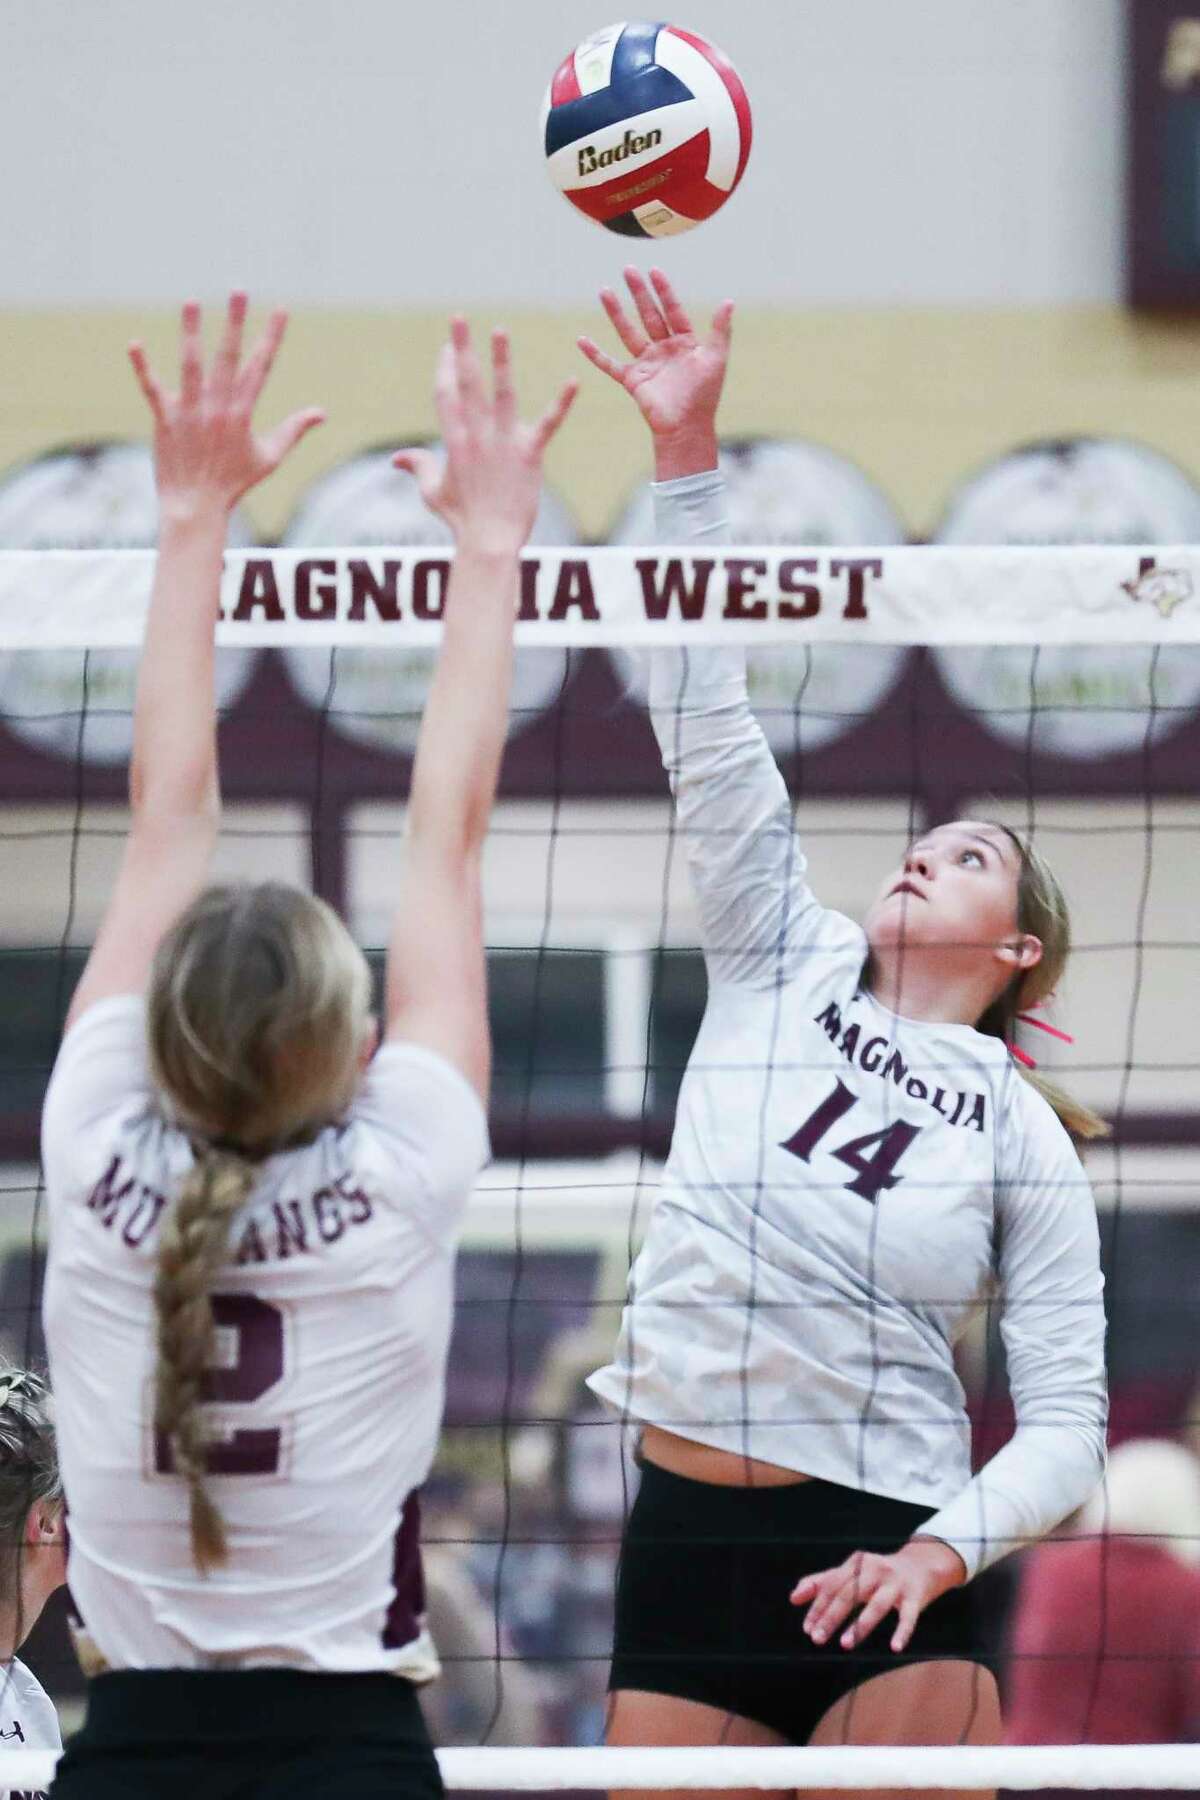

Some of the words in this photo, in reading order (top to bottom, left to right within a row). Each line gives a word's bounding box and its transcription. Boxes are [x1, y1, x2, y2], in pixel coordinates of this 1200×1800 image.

[577, 128, 662, 177] Baden
[218, 559, 601, 621] AGNOIA
[635, 558, 884, 621] WEST
[813, 1001, 987, 1132] MAGNOLIA
[778, 1075, 924, 1205] 14
[86, 1154, 374, 1266] MUANGS
[150, 1290, 287, 1478] 2
